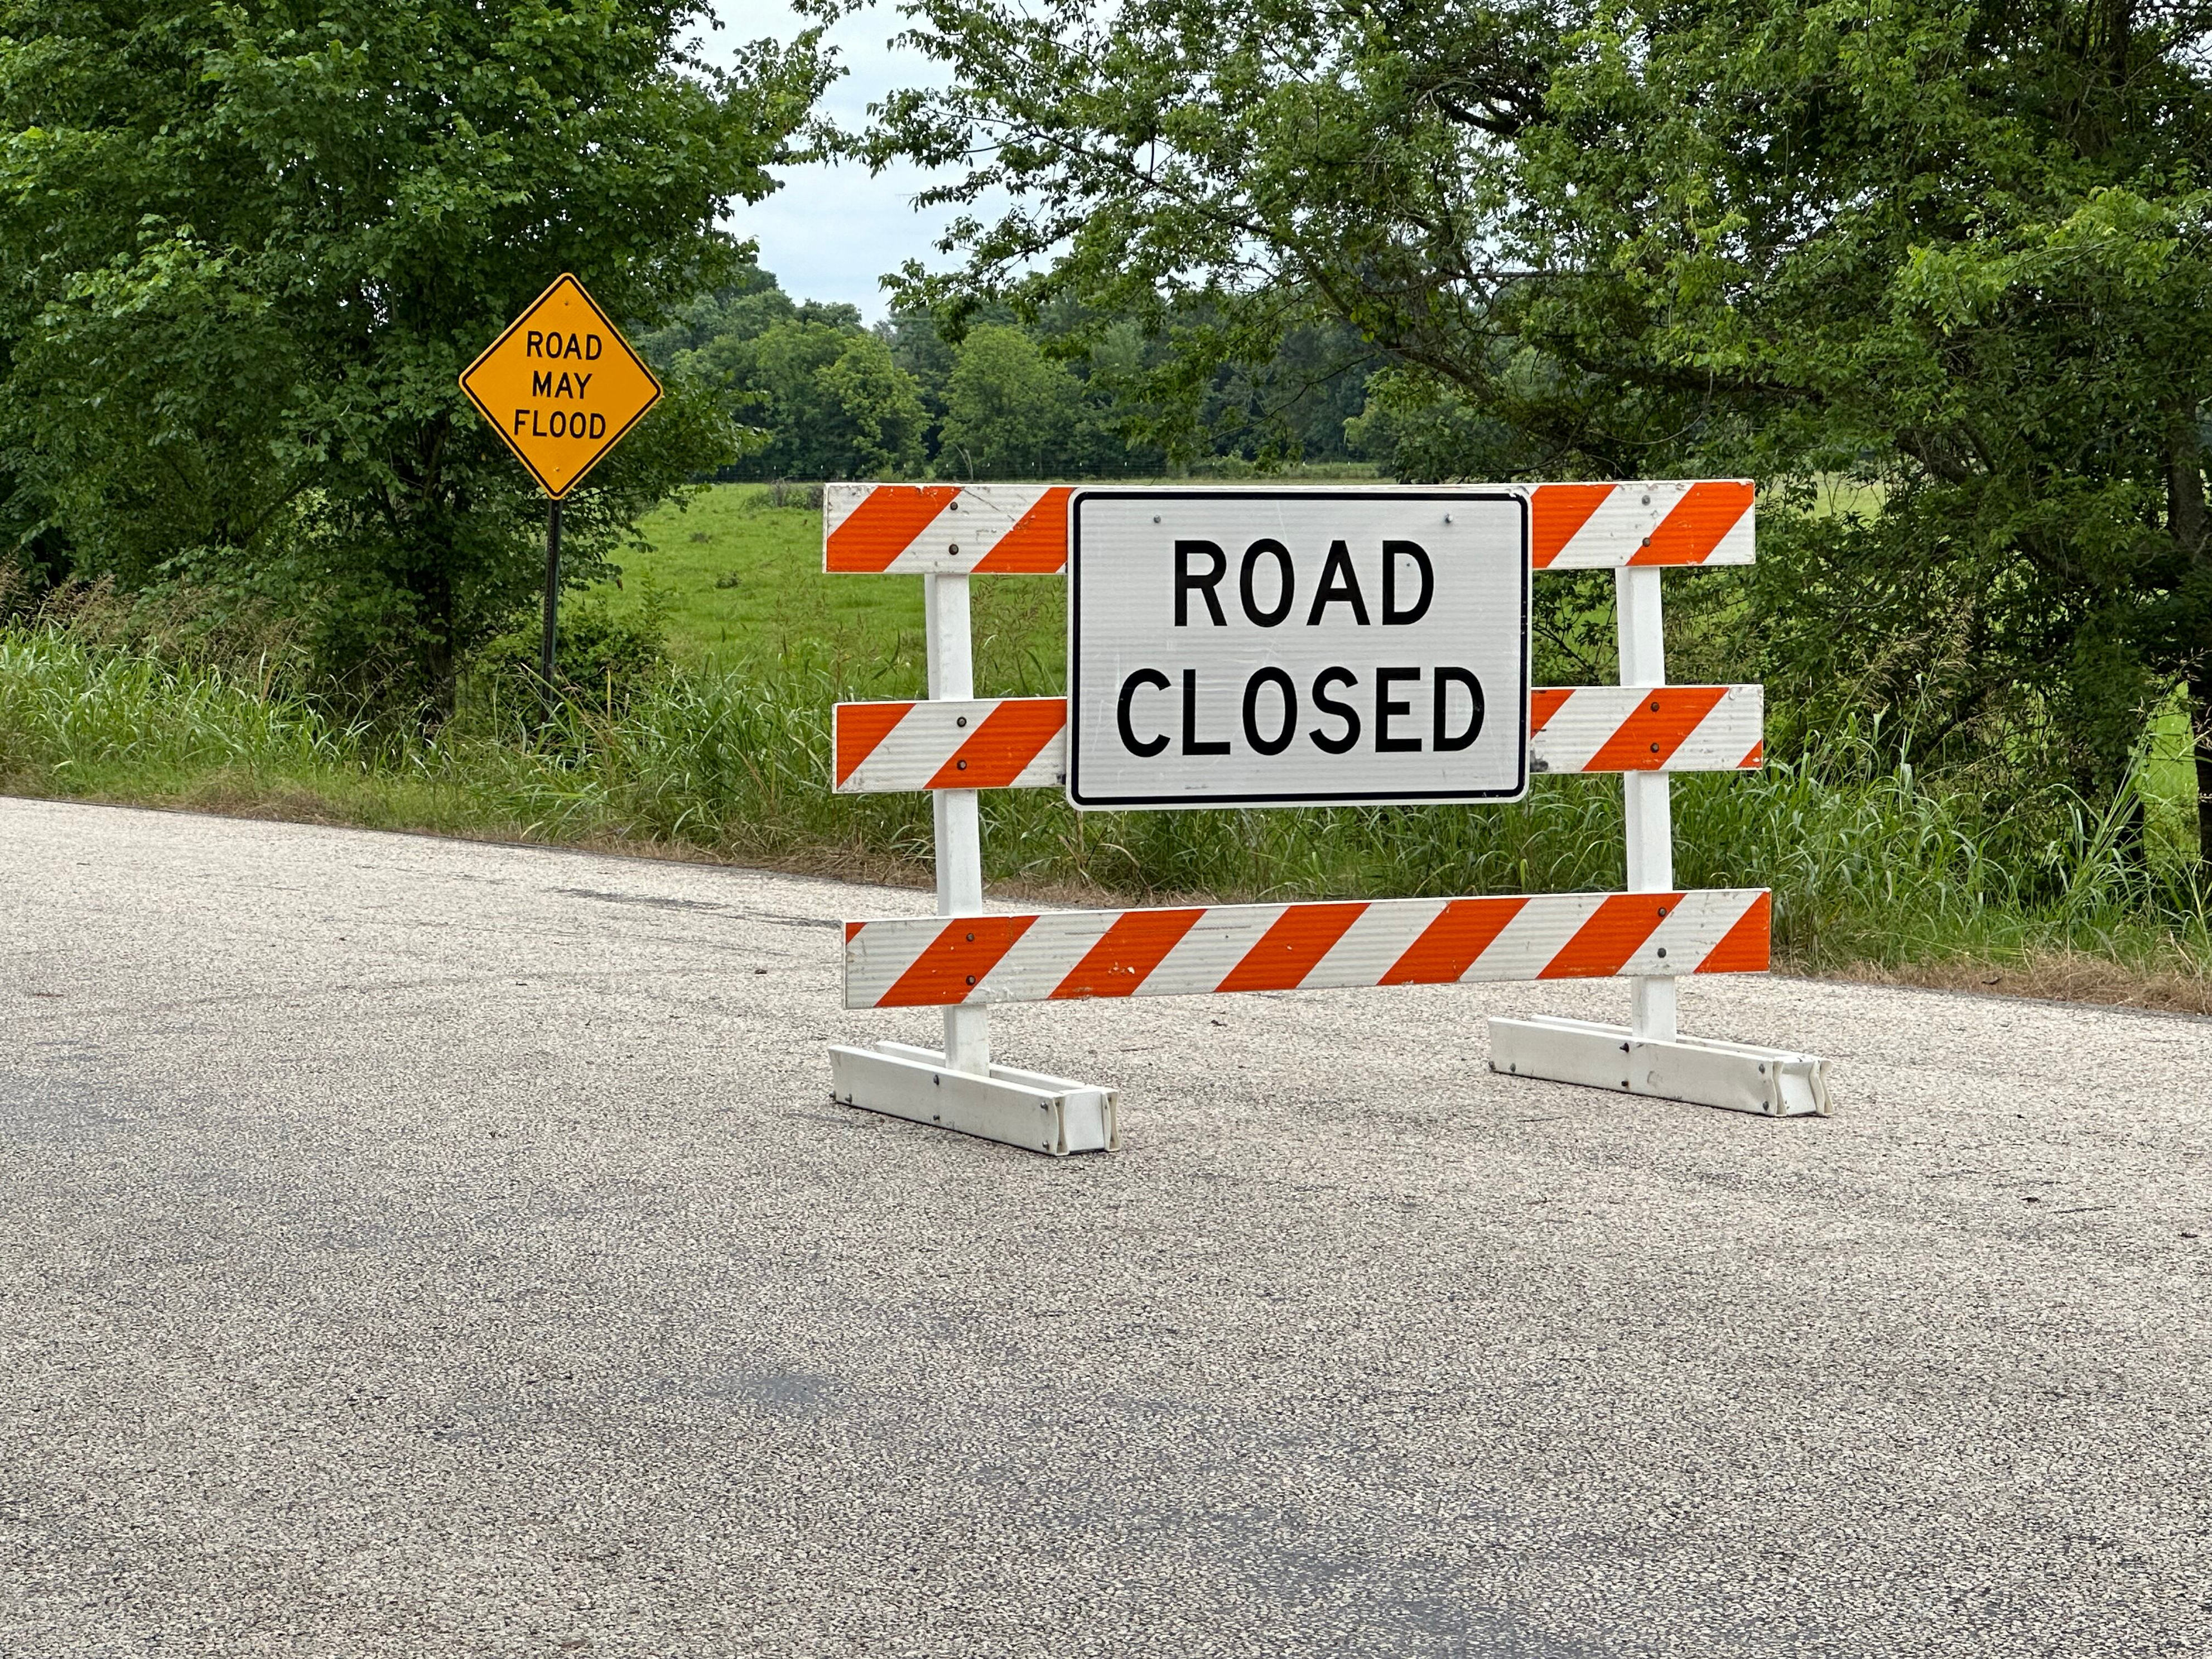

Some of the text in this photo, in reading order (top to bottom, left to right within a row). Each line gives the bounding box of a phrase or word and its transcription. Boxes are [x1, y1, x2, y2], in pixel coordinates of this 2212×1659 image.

[526, 330, 603, 361] ROAD
[532, 370, 592, 400] MAY
[514, 409, 606, 440] FLOOD
[1174, 538, 1434, 628] ROAD
[1117, 666, 1485, 758] CLOSED
